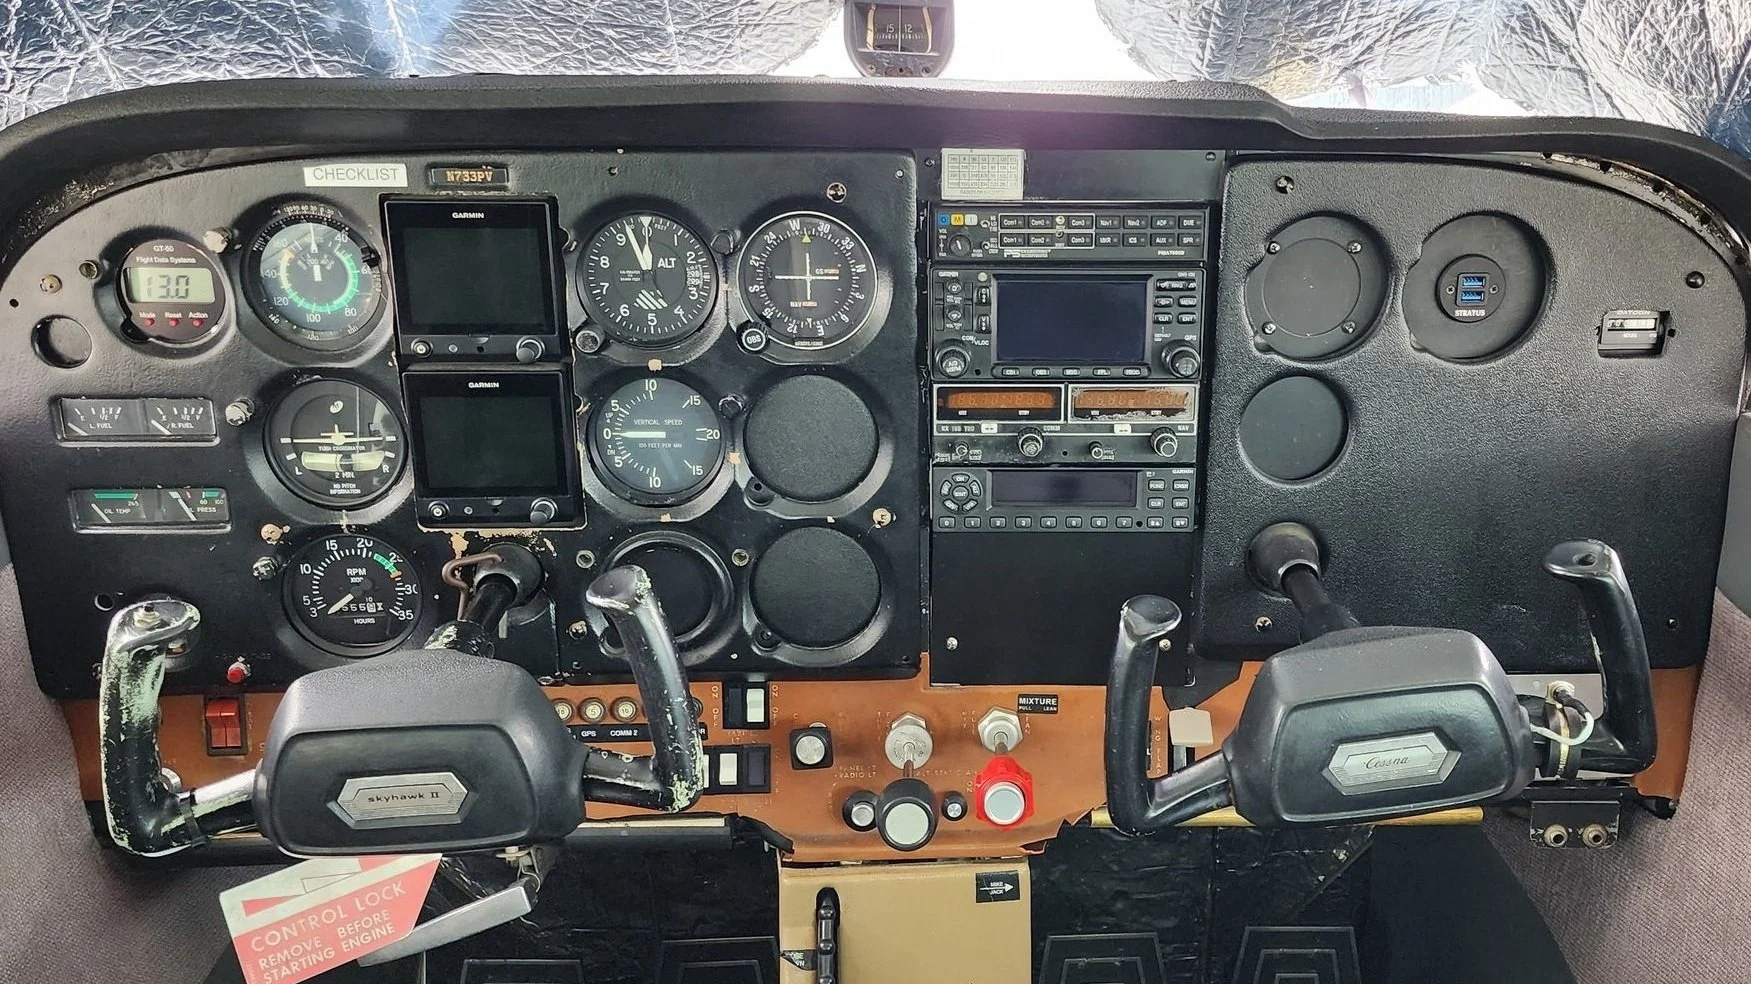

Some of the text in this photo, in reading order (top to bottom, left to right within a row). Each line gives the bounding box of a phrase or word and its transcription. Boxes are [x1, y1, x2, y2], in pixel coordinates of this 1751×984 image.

[886, 24, 894, 32] 15
[904, 24, 912, 32] 12
[313, 168, 399, 180] CHECKLIST
[446, 170, 493, 182] N733PV
[789, 220, 800, 231] W
[817, 222, 831, 233] 30
[334, 233, 348, 242] 40
[616, 233, 626, 246] 9
[674, 234, 677, 246] 1
[764, 232, 776, 244] 24
[841, 237, 855, 250] 33
[600, 256, 609, 268] 8
[687, 251, 695, 263] 2
[750, 255, 760, 267] 21
[658, 258, 676, 268] ALT
[854, 264, 867, 273] N
[600, 283, 609, 295] 7
[689, 288, 698, 299] 3
[749, 285, 760, 293] S
[273, 297, 288, 305] 120
[344, 307, 356, 316] 80
[620, 304, 629, 316] 6
[674, 305, 684, 315] 4
[762, 307, 774, 319] 15
[306, 314, 321, 322] 100
[647, 314, 657, 326] 5
[840, 311, 849, 323] 6
[787, 323, 798, 333] 12
[816, 325, 825, 336] E
[746, 335, 761, 344] OBS
[645, 380, 657, 391] 10
[611, 400, 620, 411] 5
[690, 395, 701, 405] 15
[603, 428, 612, 440] 0
[706, 430, 720, 439] 20
[614, 456, 623, 467] 5
[295, 466, 302, 475] L
[382, 465, 389, 473] R
[692, 466, 703, 476] 15
[649, 477, 661, 488] 10
[326, 540, 338, 550] 15
[357, 538, 373, 547] 20
[300, 564, 311, 574] 10
[347, 568, 366, 576] RPM
[303, 596, 311, 605] 5
[310, 608, 318, 617] 3
[398, 610, 414, 620] 35
[712, 685, 719, 699] ON
[772, 685, 778, 697] ON
[1018, 697, 1057, 705] MIXTURE
[590, 707, 596, 716] 5
[1364, 756, 1409, 770] Cessna
[368, 793, 425, 803] skyhawk
[251, 882, 406, 952] CONTROL LOCK
[258, 910, 391, 970] REMOVE BEFORE
[263, 947, 335, 984] STARTING
[342, 924, 396, 952] ENGINE
